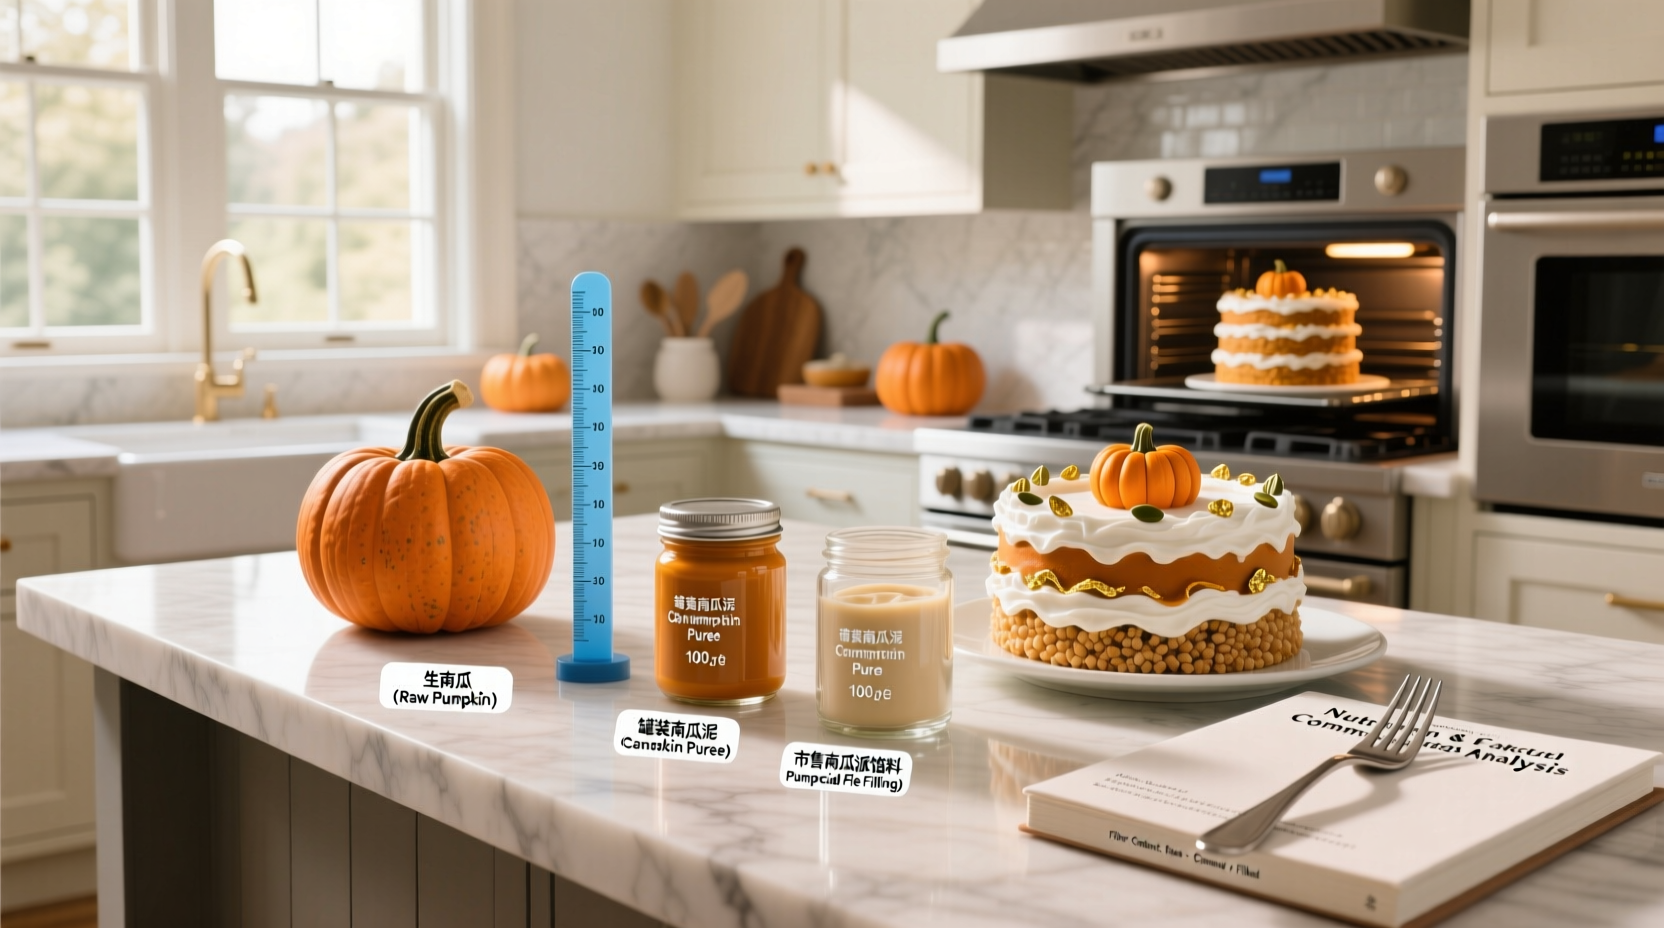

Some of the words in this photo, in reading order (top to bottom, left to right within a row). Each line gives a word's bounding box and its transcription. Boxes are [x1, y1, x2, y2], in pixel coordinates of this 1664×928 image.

[852, 662, 883, 676] Pure
[423, 670, 472, 689] 生南瓜
[393, 689, 429, 705] (Raw
[432, 691, 498, 710] Pumpkin)
[686, 741, 731, 759] Puree)
[1464, 748, 1569, 775] Analysis
[863, 776, 903, 793] Filling)
